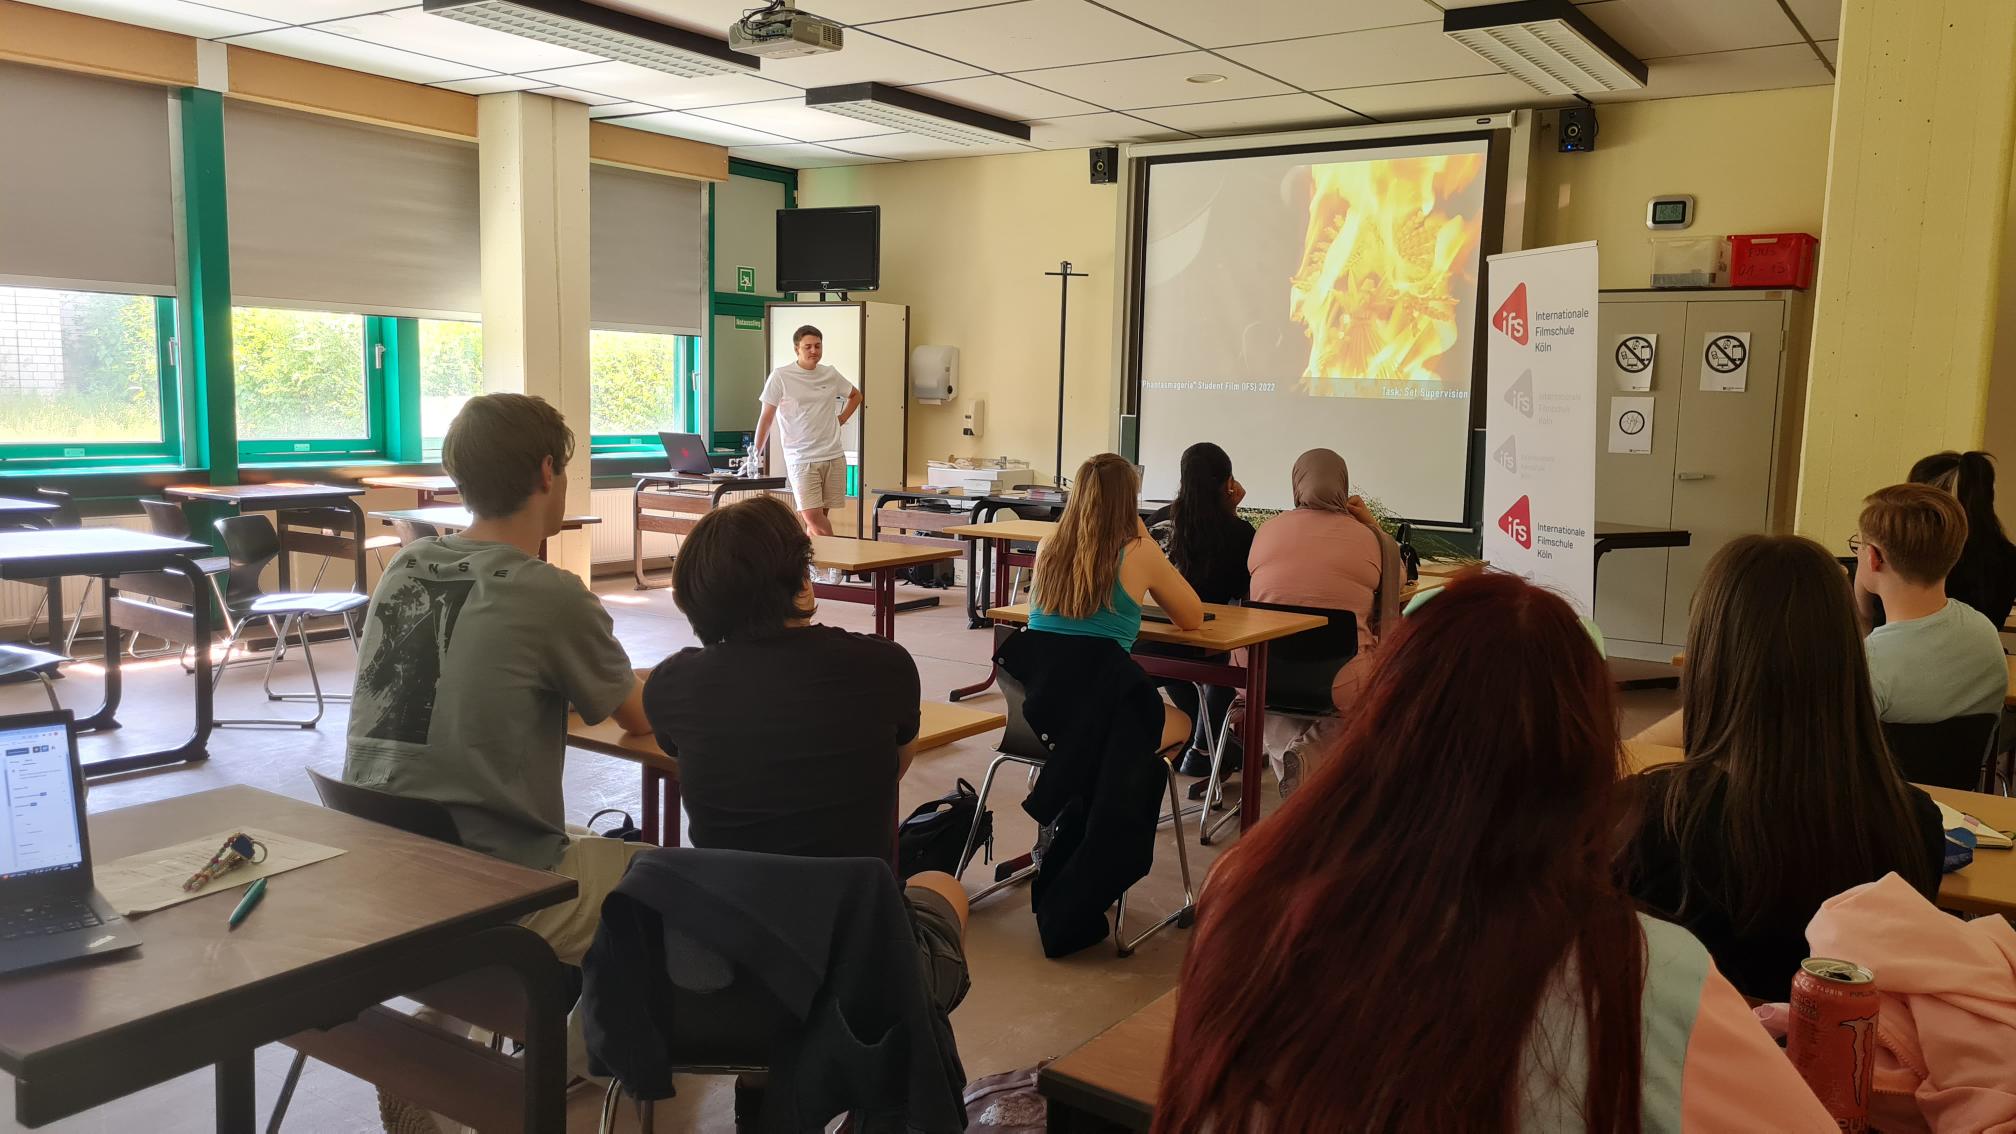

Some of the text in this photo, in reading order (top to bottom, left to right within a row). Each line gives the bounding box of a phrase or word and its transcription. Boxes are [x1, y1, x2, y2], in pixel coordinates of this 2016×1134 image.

[1535, 308, 1589, 321] Internationale
[1502, 311, 1524, 338] ifs
[1535, 325, 1575, 336] Filmschule
[1535, 342, 1552, 352] Köln
[1198, 381, 1223, 390] Student
[1225, 381, 1240, 390] Film
[1258, 382, 1276, 392] 2022
[1420, 388, 1468, 399] Supervision
[1512, 390, 1530, 413] ifs
[1500, 450, 1514, 468] ifs
[1508, 515, 1527, 541] ifs
[1537, 522, 1585, 537] Internationale
[1537, 535, 1574, 549] Filmschule
[1537, 549, 1553, 559] Köln
[1816, 984, 1844, 997] TAURIN
